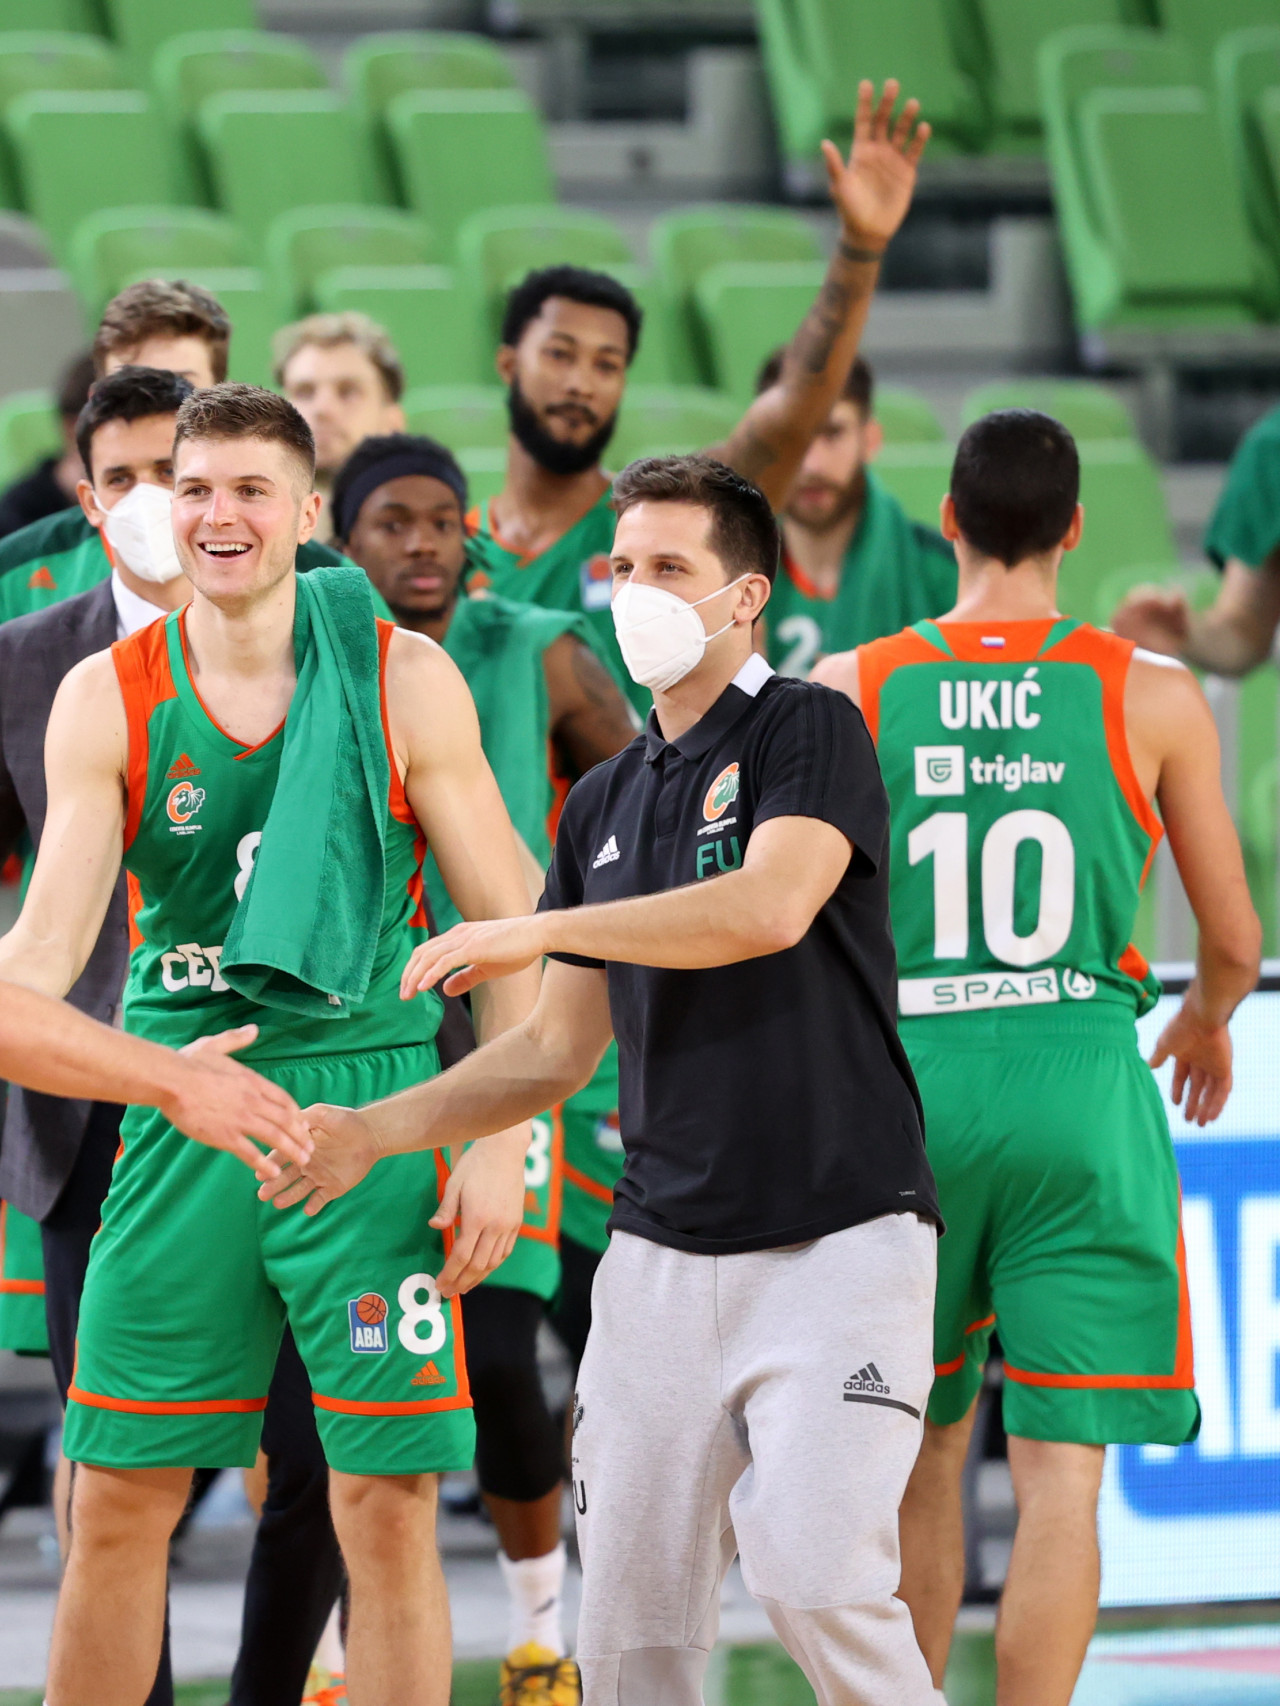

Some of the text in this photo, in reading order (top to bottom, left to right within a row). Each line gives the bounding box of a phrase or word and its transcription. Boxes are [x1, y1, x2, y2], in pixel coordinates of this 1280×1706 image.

[939, 667, 1042, 730] UKIĆ
[969, 753, 1065, 792] triglav
[696, 836, 742, 879] FU
[908, 809, 1075, 967] 10
[933, 976, 1054, 1005] SPAR
[397, 1273, 447, 1355] 8
[355, 1326, 383, 1348] ABA
[844, 1379, 890, 1394] adidas
